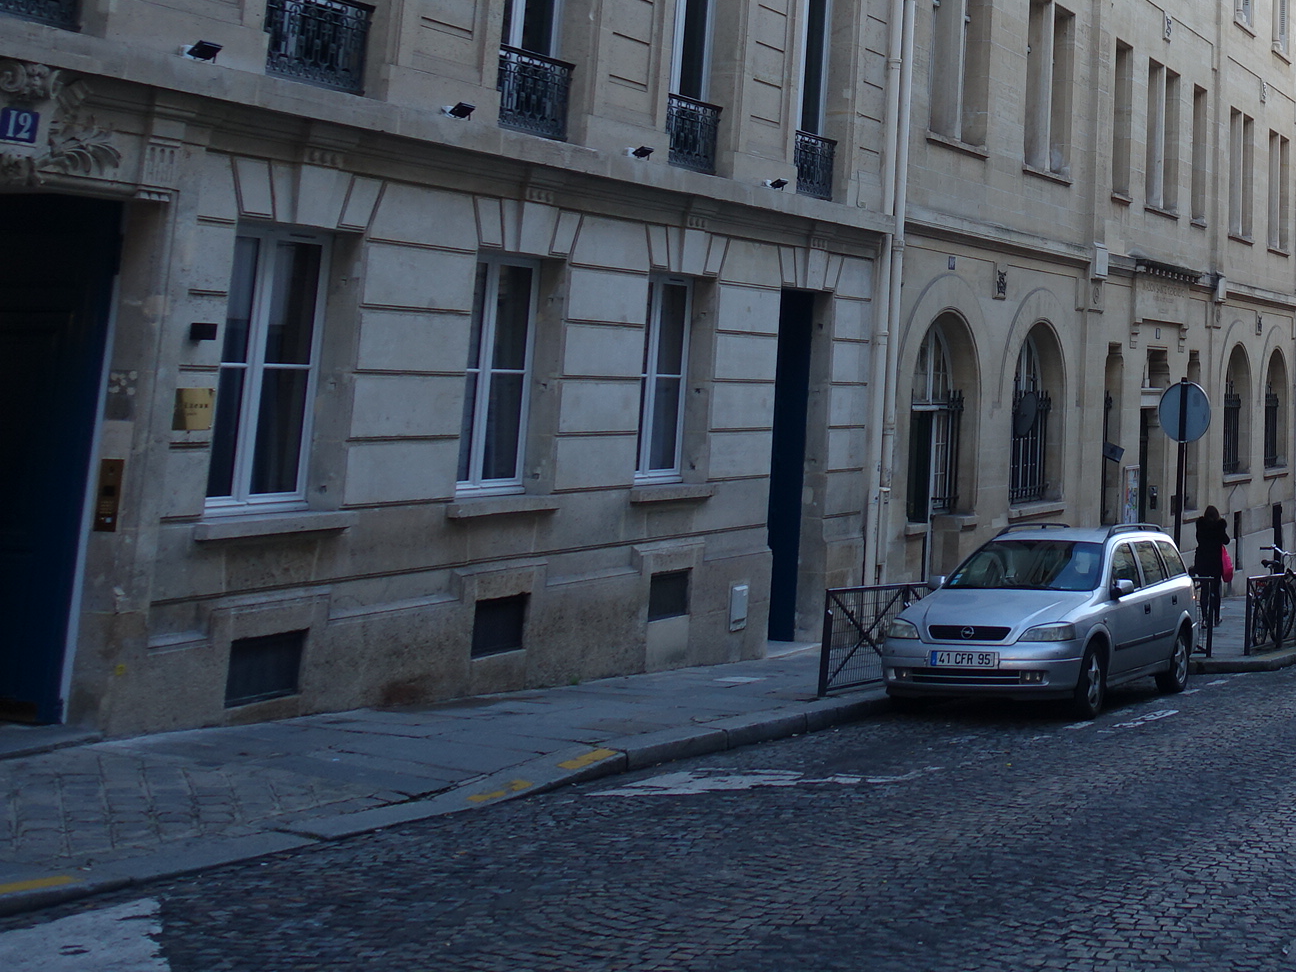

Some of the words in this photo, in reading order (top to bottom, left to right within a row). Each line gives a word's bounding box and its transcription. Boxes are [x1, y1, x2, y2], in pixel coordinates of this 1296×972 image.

[6, 110, 32, 138] 12
[939, 652, 951, 664] 41
[954, 652, 974, 665] CFR
[977, 653, 991, 665] 95
